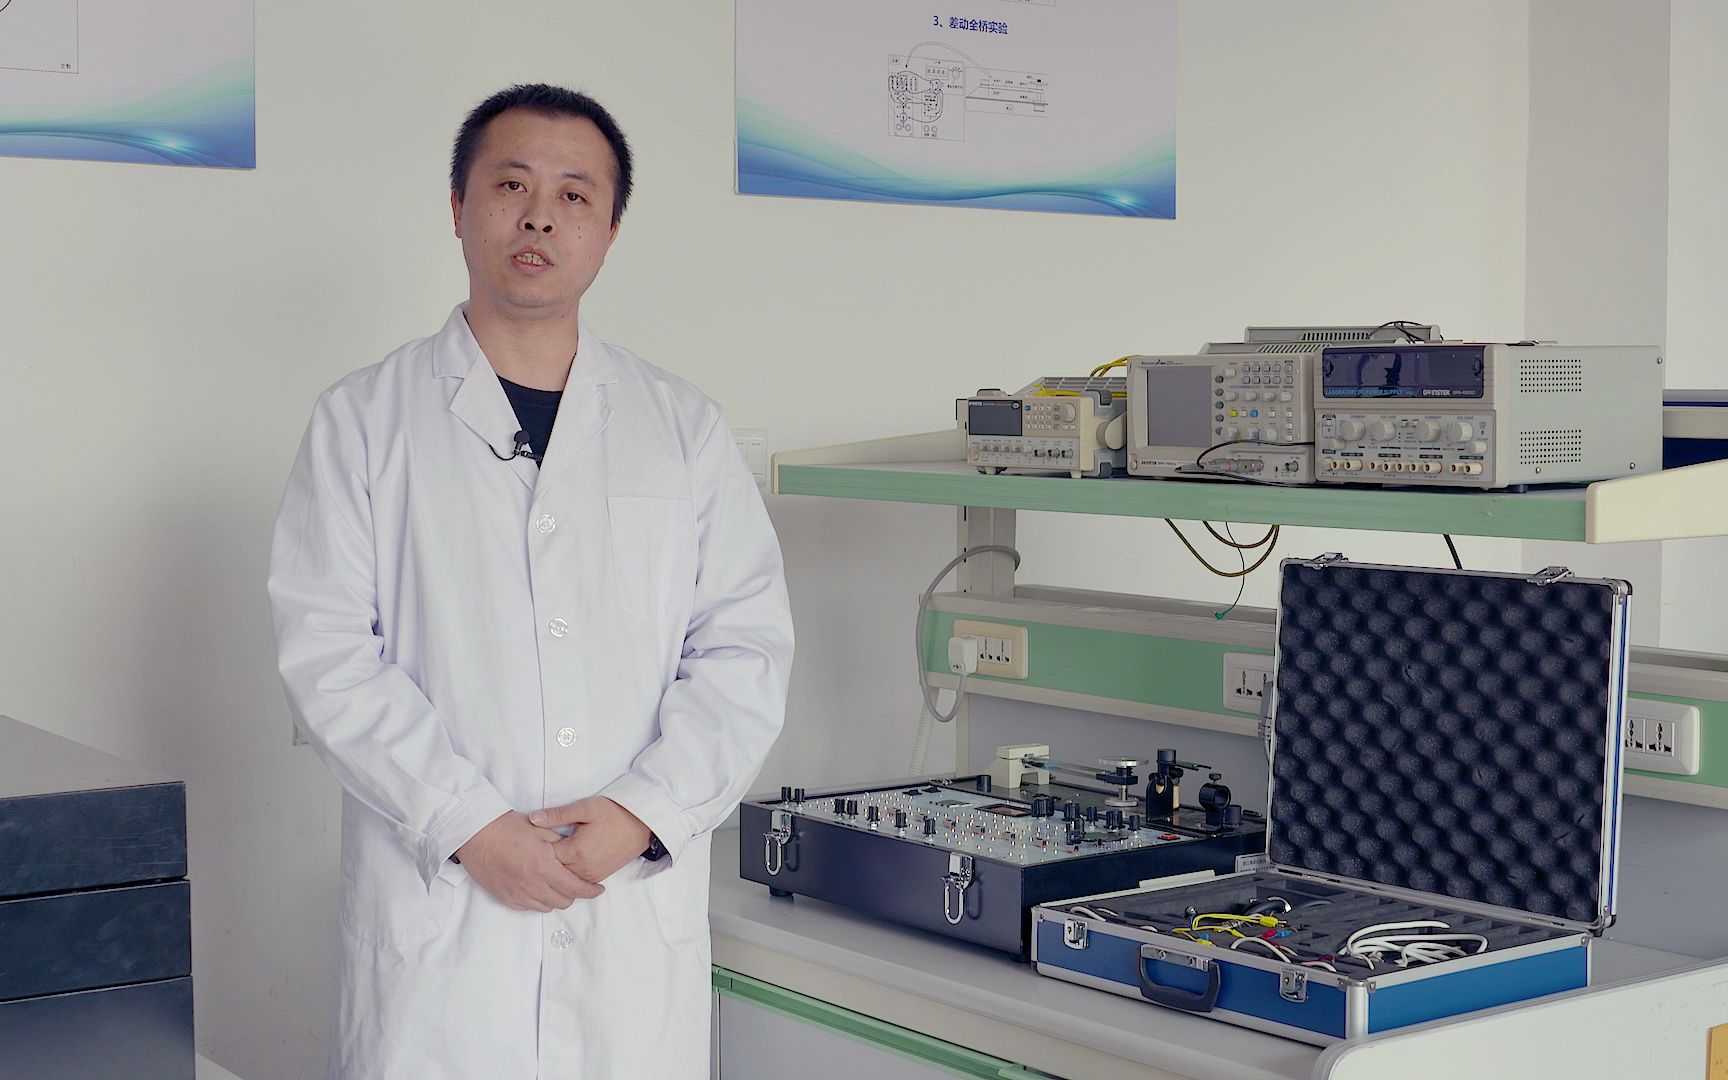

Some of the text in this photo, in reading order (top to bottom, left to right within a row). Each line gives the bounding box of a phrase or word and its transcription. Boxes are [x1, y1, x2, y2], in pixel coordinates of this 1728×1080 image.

[933, 15, 1008, 34] 3、差动全桥实验
